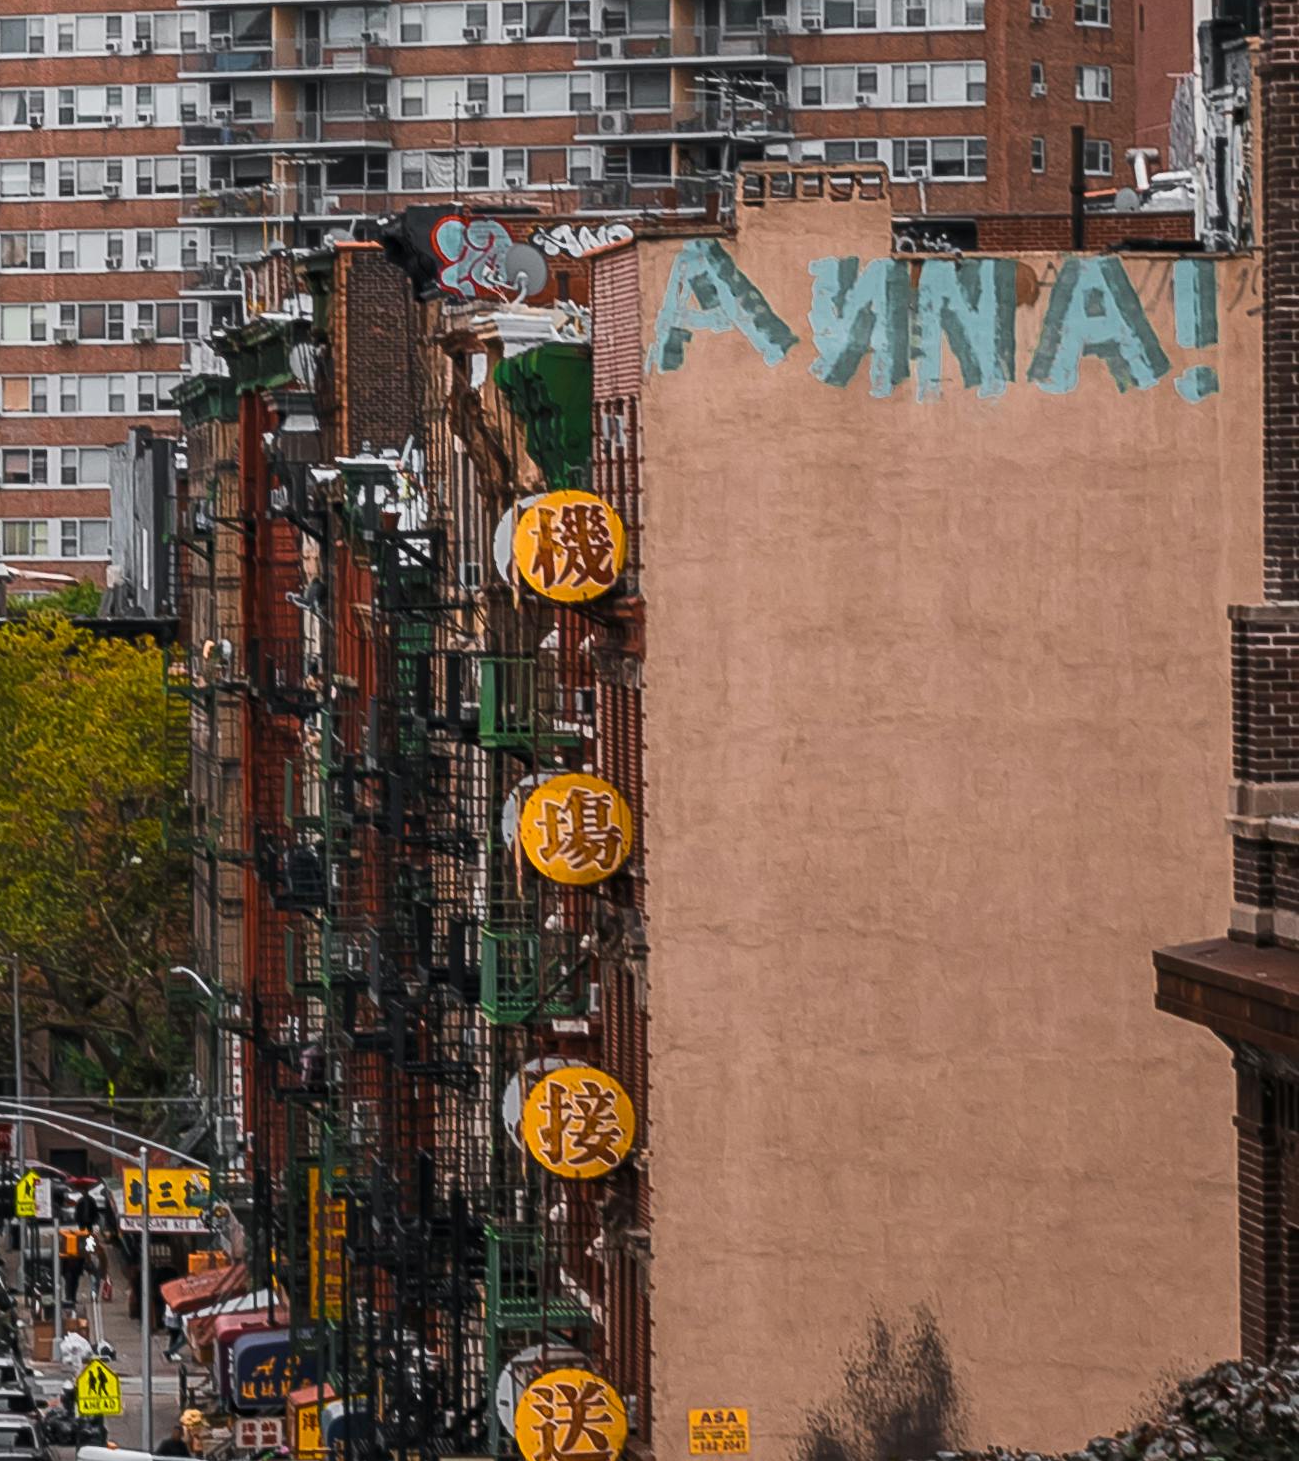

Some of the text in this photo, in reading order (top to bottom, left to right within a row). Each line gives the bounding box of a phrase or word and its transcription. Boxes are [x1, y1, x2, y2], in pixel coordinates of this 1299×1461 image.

[530, 503, 616, 591] 機
[537, 786, 626, 871] 場
[539, 1082, 625, 1172] 接
[83, 1398, 116, 1410] AHEAD
[701, 1410, 738, 1424] ASA
